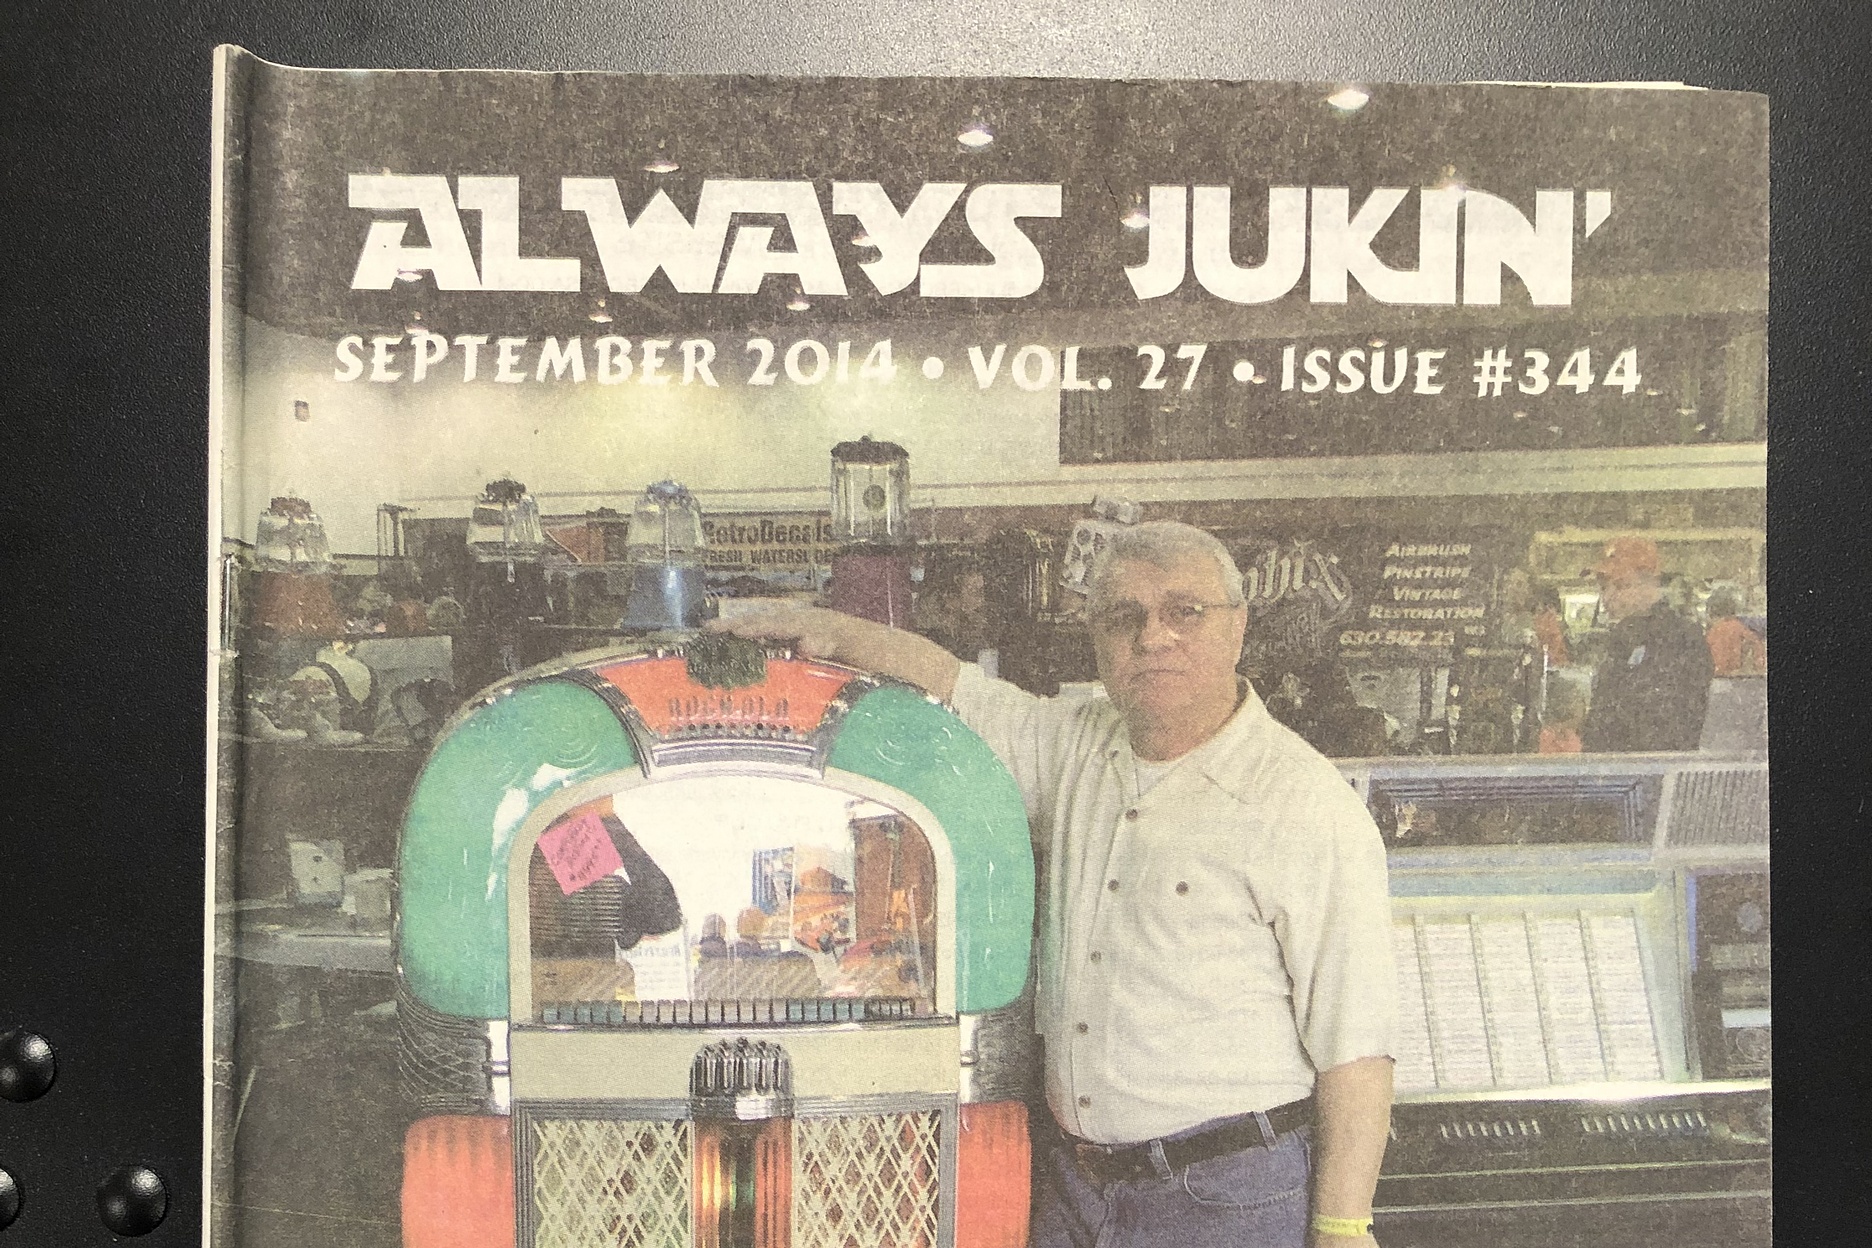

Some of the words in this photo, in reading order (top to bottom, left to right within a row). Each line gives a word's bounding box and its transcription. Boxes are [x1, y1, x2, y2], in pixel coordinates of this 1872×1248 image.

[348, 173, 1063, 298] ALWAYS
[1123, 184, 1612, 306] JUKIN'
[334, 334, 719, 387] SEPTEMBER
[746, 338, 898, 386] 2014
[967, 343, 1113, 392] VOL.
[1136, 344, 1209, 391] 27
[1279, 345, 1448, 396] ISSUE
[1472, 345, 1643, 398] #344
